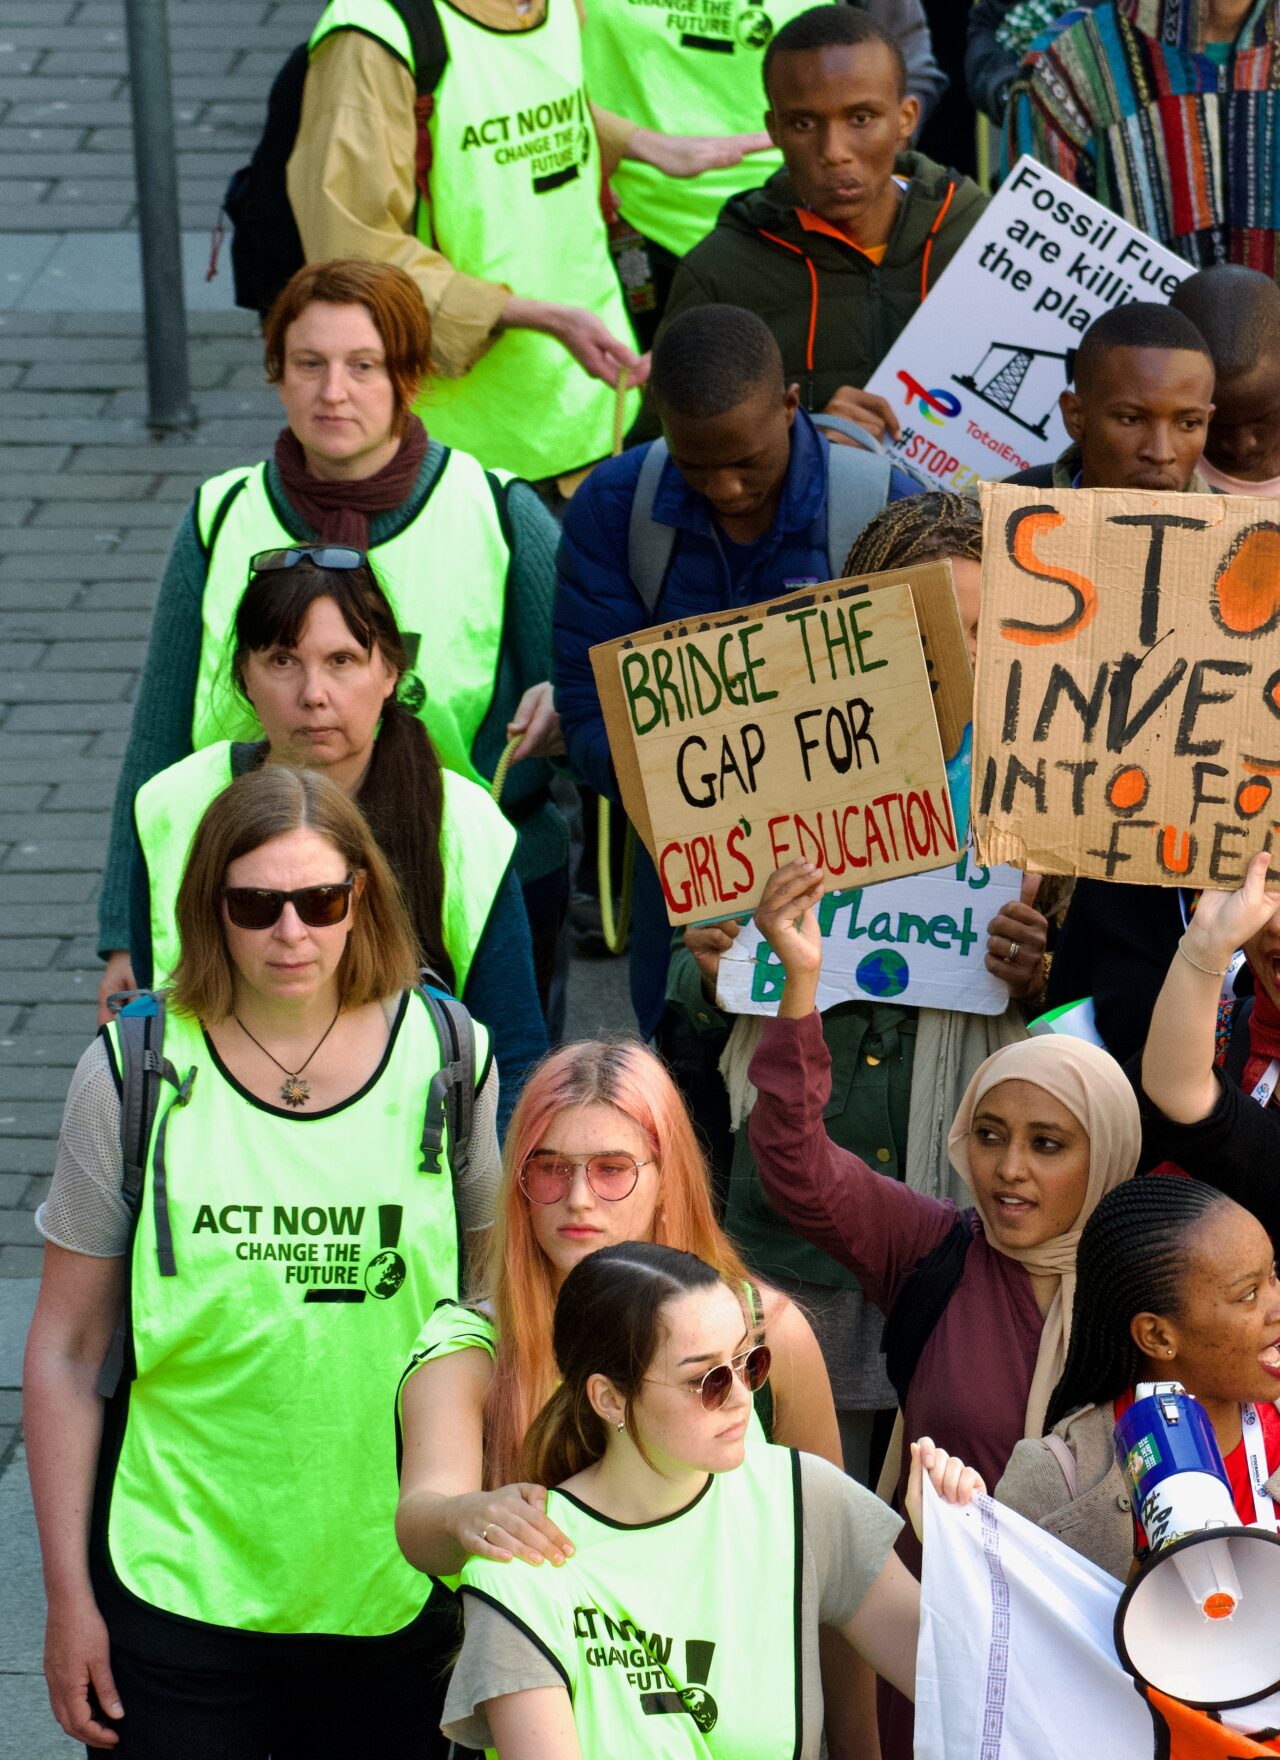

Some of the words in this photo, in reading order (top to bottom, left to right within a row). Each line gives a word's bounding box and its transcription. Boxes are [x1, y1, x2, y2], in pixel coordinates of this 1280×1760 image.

[666, 14, 730, 35] FUTURE
[460, 116, 511, 151] ACT
[517, 95, 574, 136] NOW
[494, 136, 550, 165] CHANGE
[554, 127, 573, 149] THE
[531, 147, 573, 175] FUTURE
[1009, 167, 1118, 251] Fossil
[1116, 238, 1181, 298] Fue
[977, 242, 1032, 293] the
[1033, 285, 1092, 333] pla
[1005, 217, 1061, 264] are
[1066, 252, 1138, 308] killi
[965, 419, 1032, 471] TotalEne
[621, 623, 779, 736] BRIDGE
[786, 600, 888, 684] THE
[676, 723, 765, 809] GAP
[794, 697, 880, 782] FOR
[978, 754, 1150, 817] INTO
[659, 817, 755, 914] GIRLS'
[768, 787, 957, 877] EDUCATION
[818, 888, 978, 957] Planet
[192, 1204, 263, 1235] ACT
[273, 1205, 366, 1236] NOW
[235, 1242, 319, 1262] CHANGE
[324, 1243, 361, 1262] THE
[285, 1265, 359, 1285] FUTURE
[573, 1606, 598, 1639] CT
